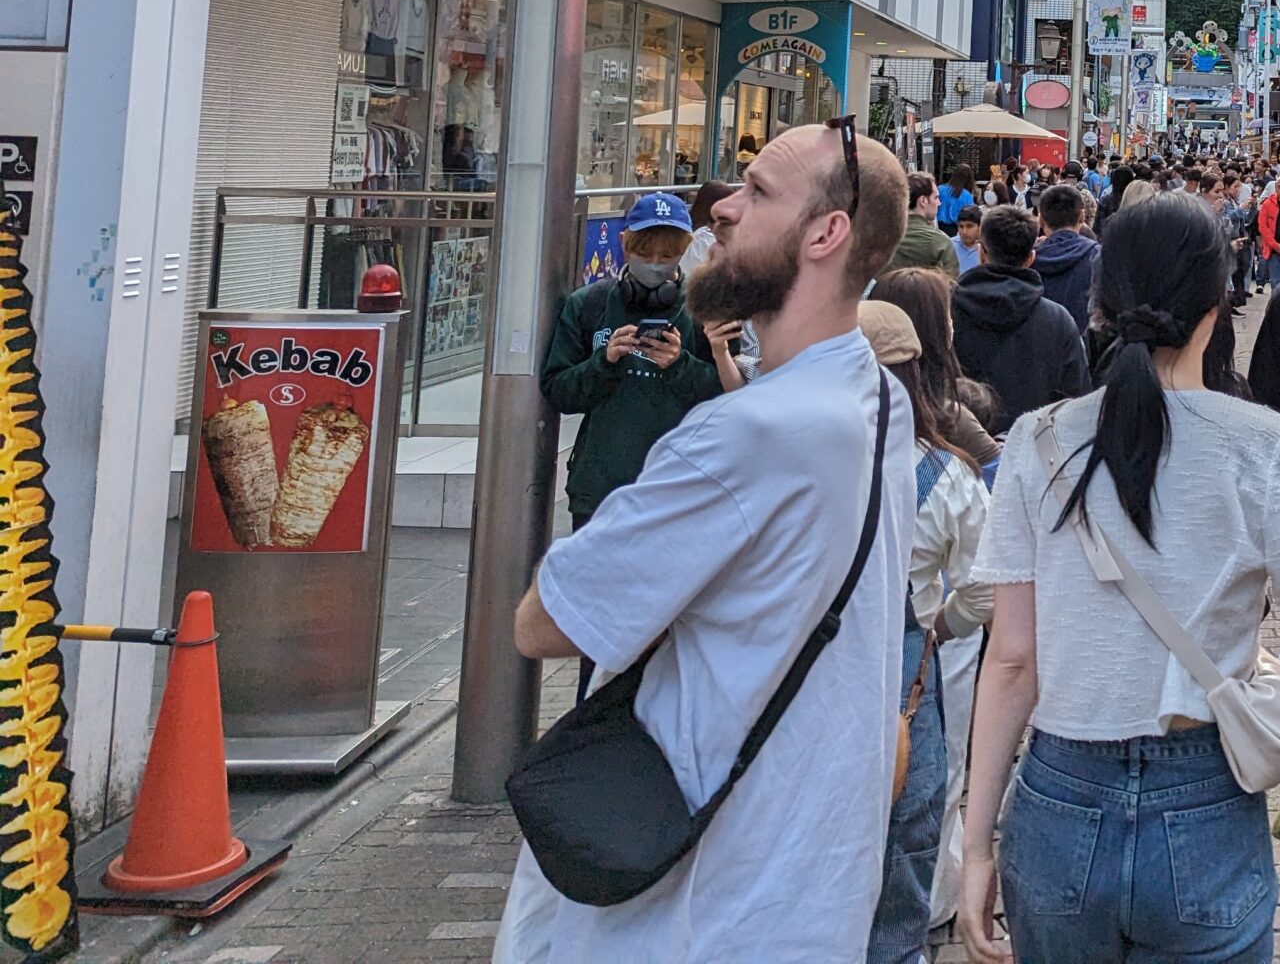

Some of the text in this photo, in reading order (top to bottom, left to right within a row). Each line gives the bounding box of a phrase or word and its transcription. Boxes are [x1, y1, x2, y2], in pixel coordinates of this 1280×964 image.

[768, 10, 798, 30] B1F
[743, 37, 822, 60] COME AGAIN
[655, 199, 671, 216] LA
[210, 337, 373, 388] Kebab
